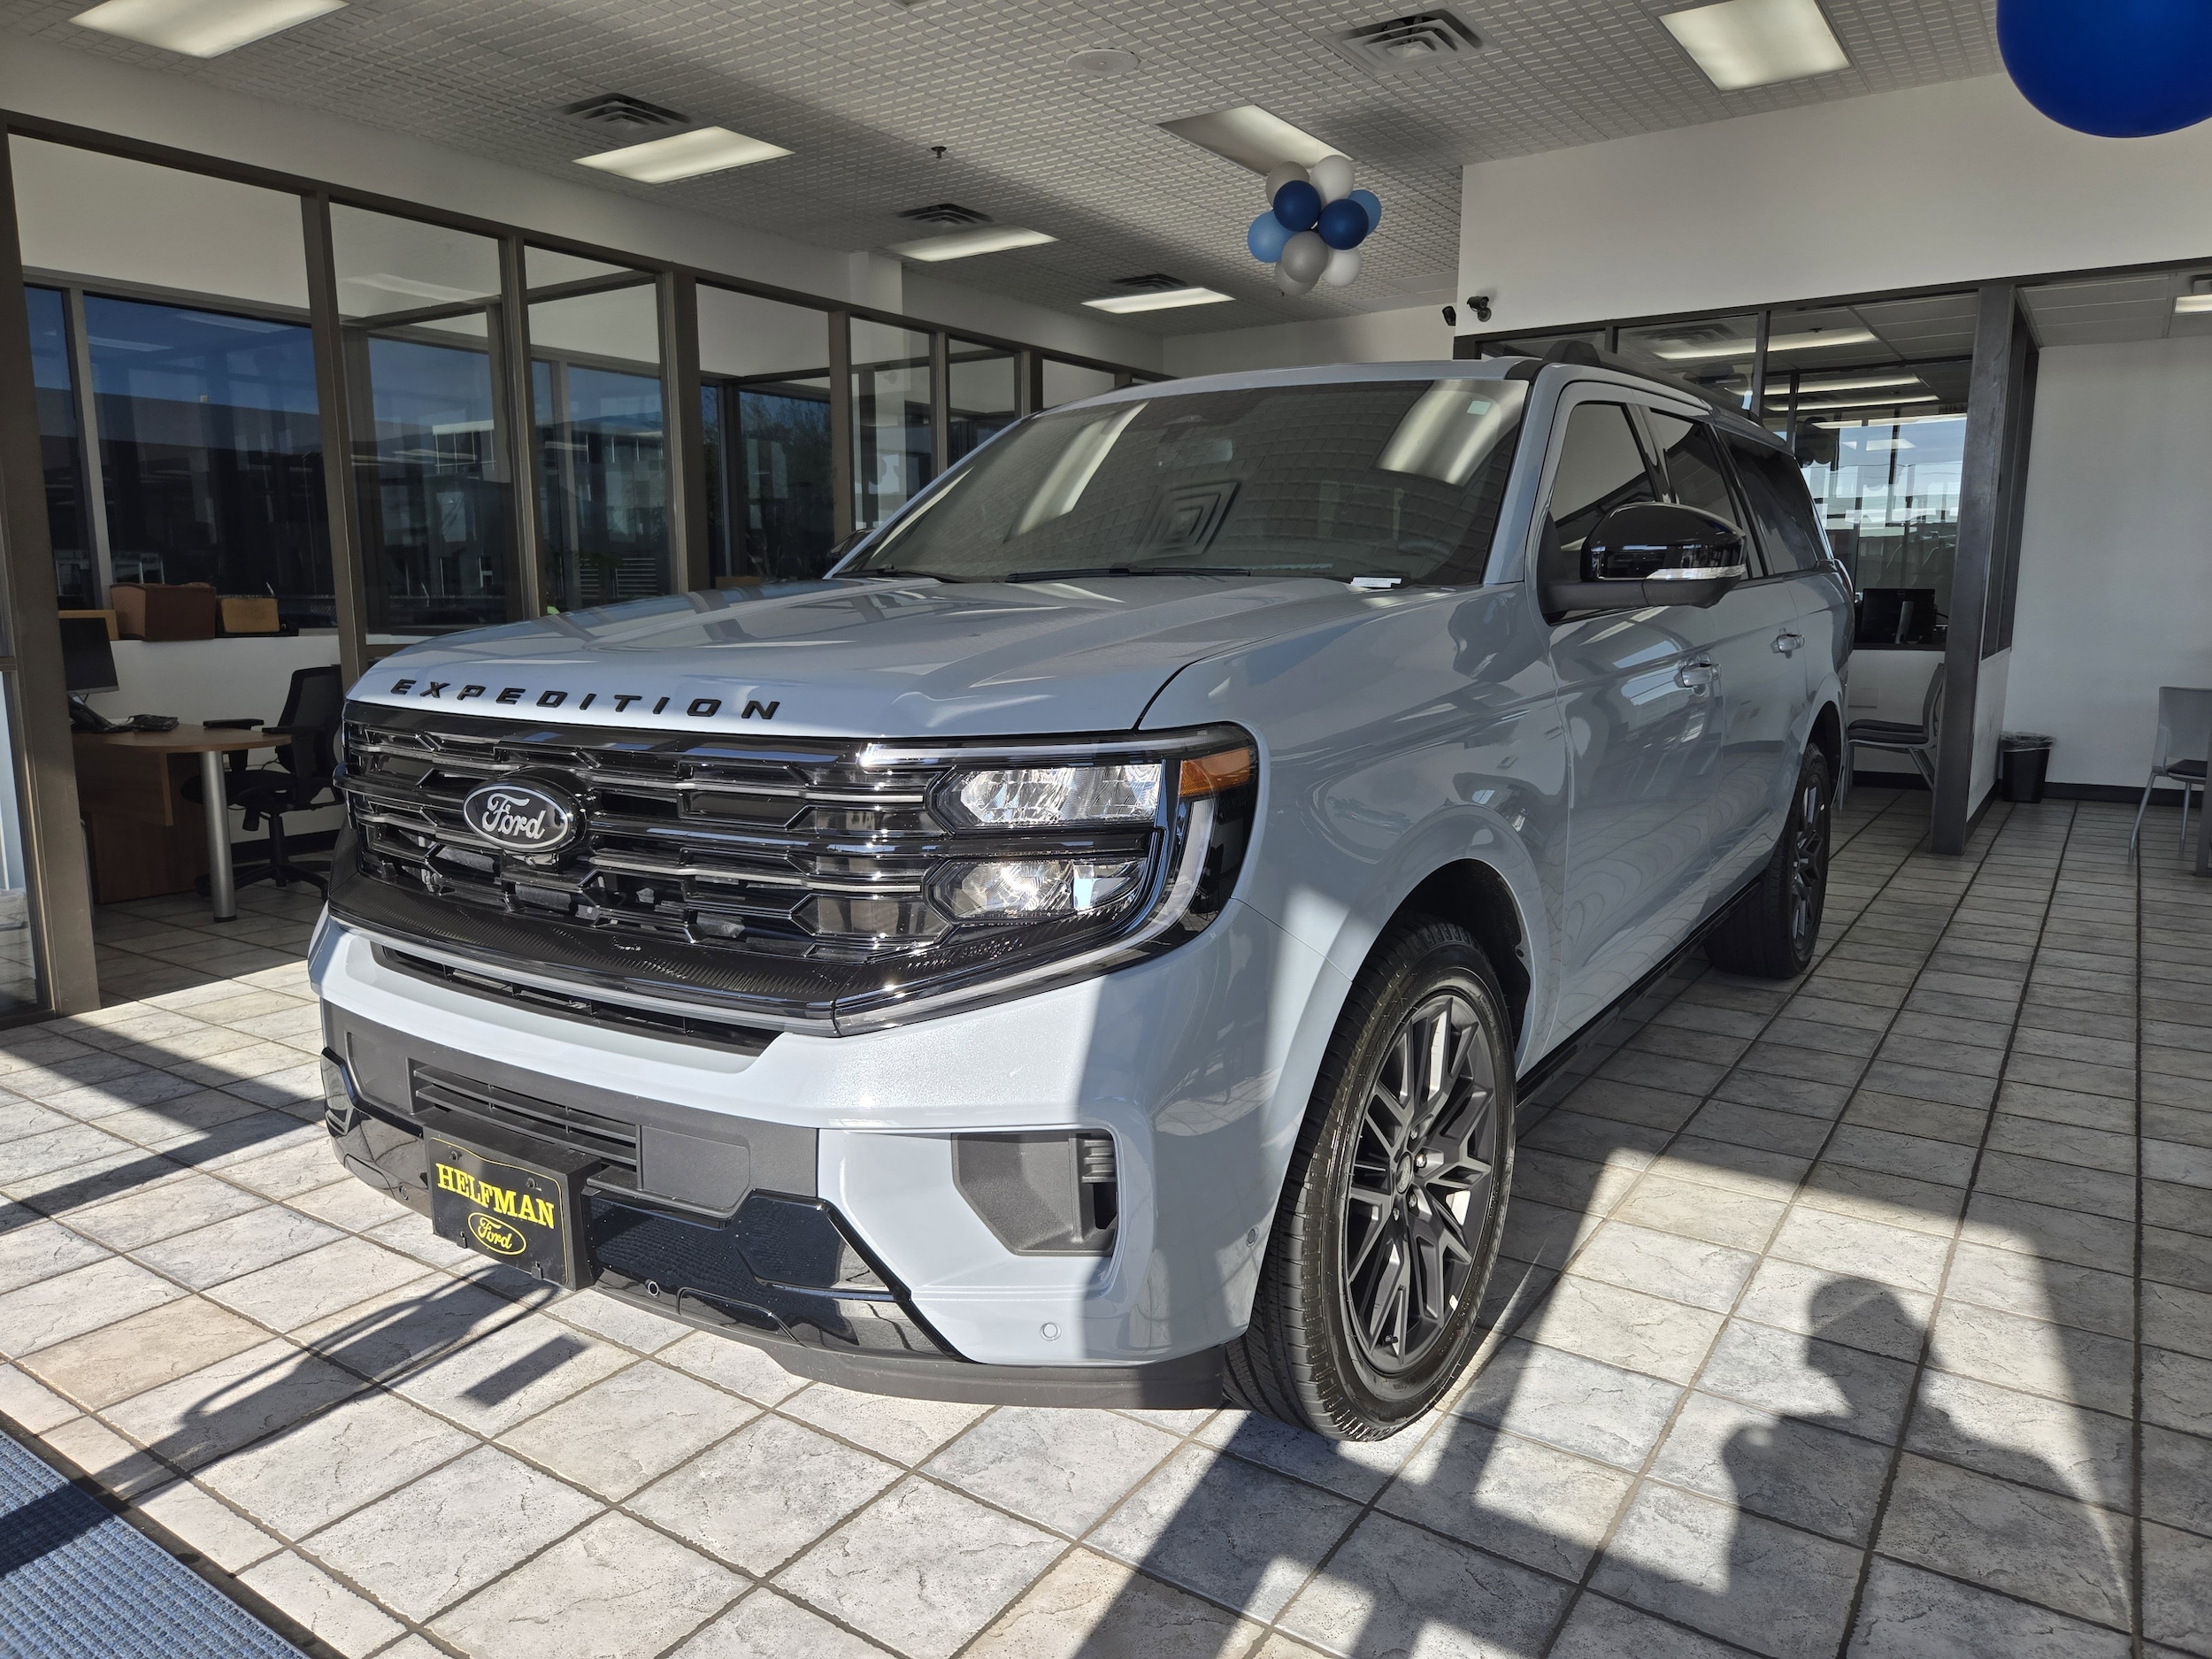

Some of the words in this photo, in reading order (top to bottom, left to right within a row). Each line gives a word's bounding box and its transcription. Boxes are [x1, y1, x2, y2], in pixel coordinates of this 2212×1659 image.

[390, 679, 780, 720] EXPEDITION
[481, 793, 546, 840] Ford
[435, 1163, 555, 1229] HELFMAN
[478, 1217, 513, 1249] Ford
